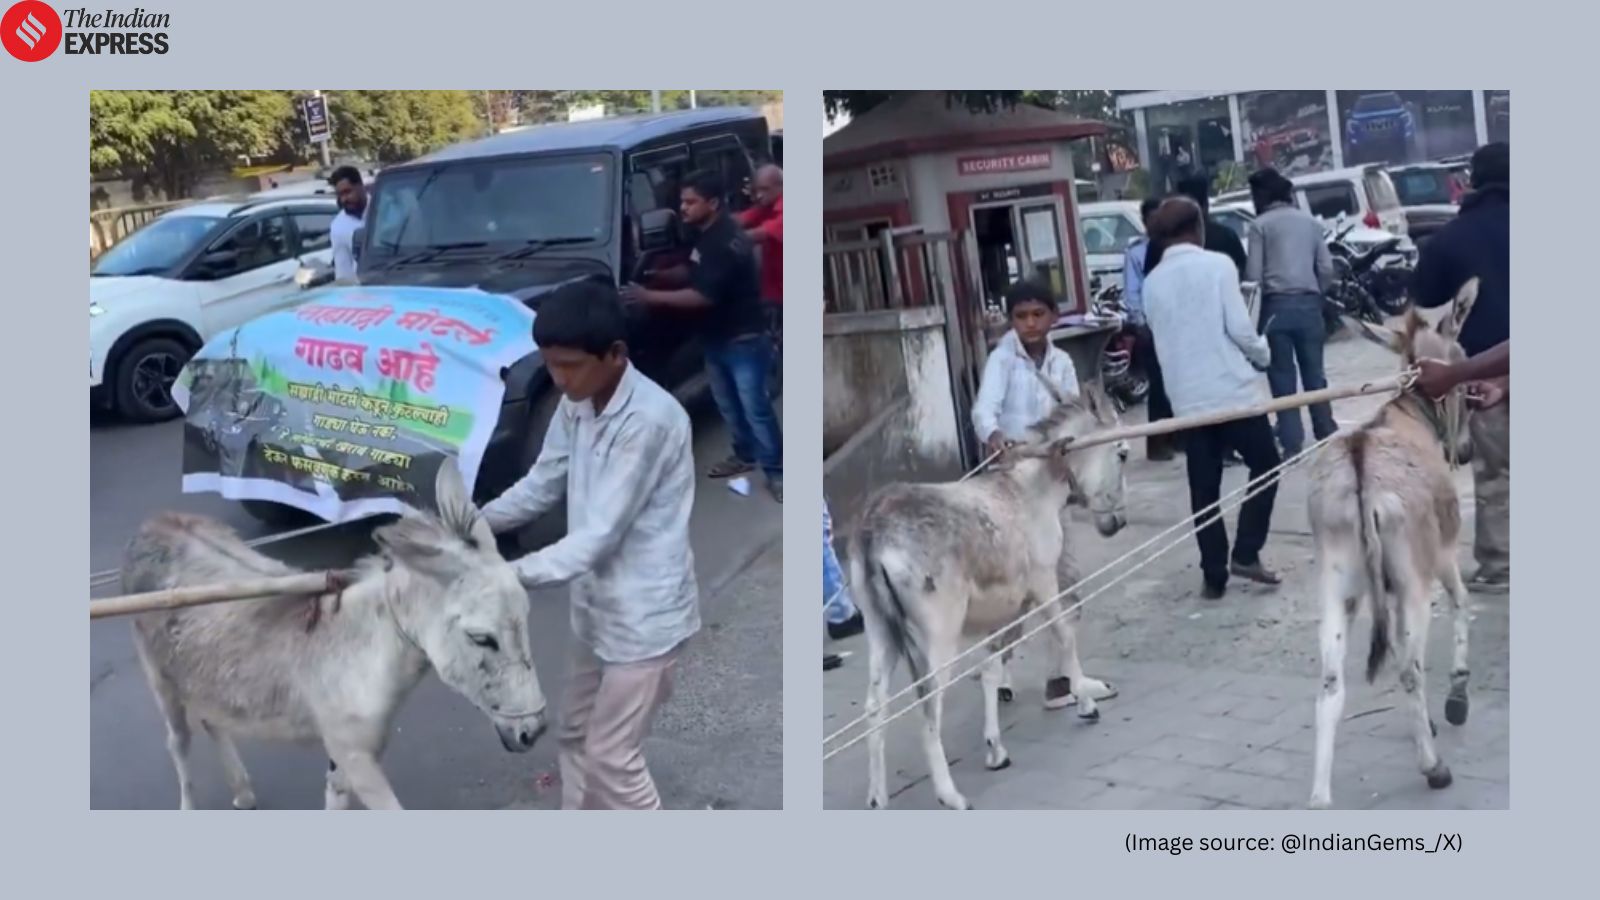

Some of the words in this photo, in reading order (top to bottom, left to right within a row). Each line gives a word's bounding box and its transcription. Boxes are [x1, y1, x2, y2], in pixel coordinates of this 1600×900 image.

[962, 156, 1016, 172] SECURITY
[1018, 152, 1050, 167] CABIN
[294, 336, 368, 374] गाढव
[376, 341, 441, 393] आहे
